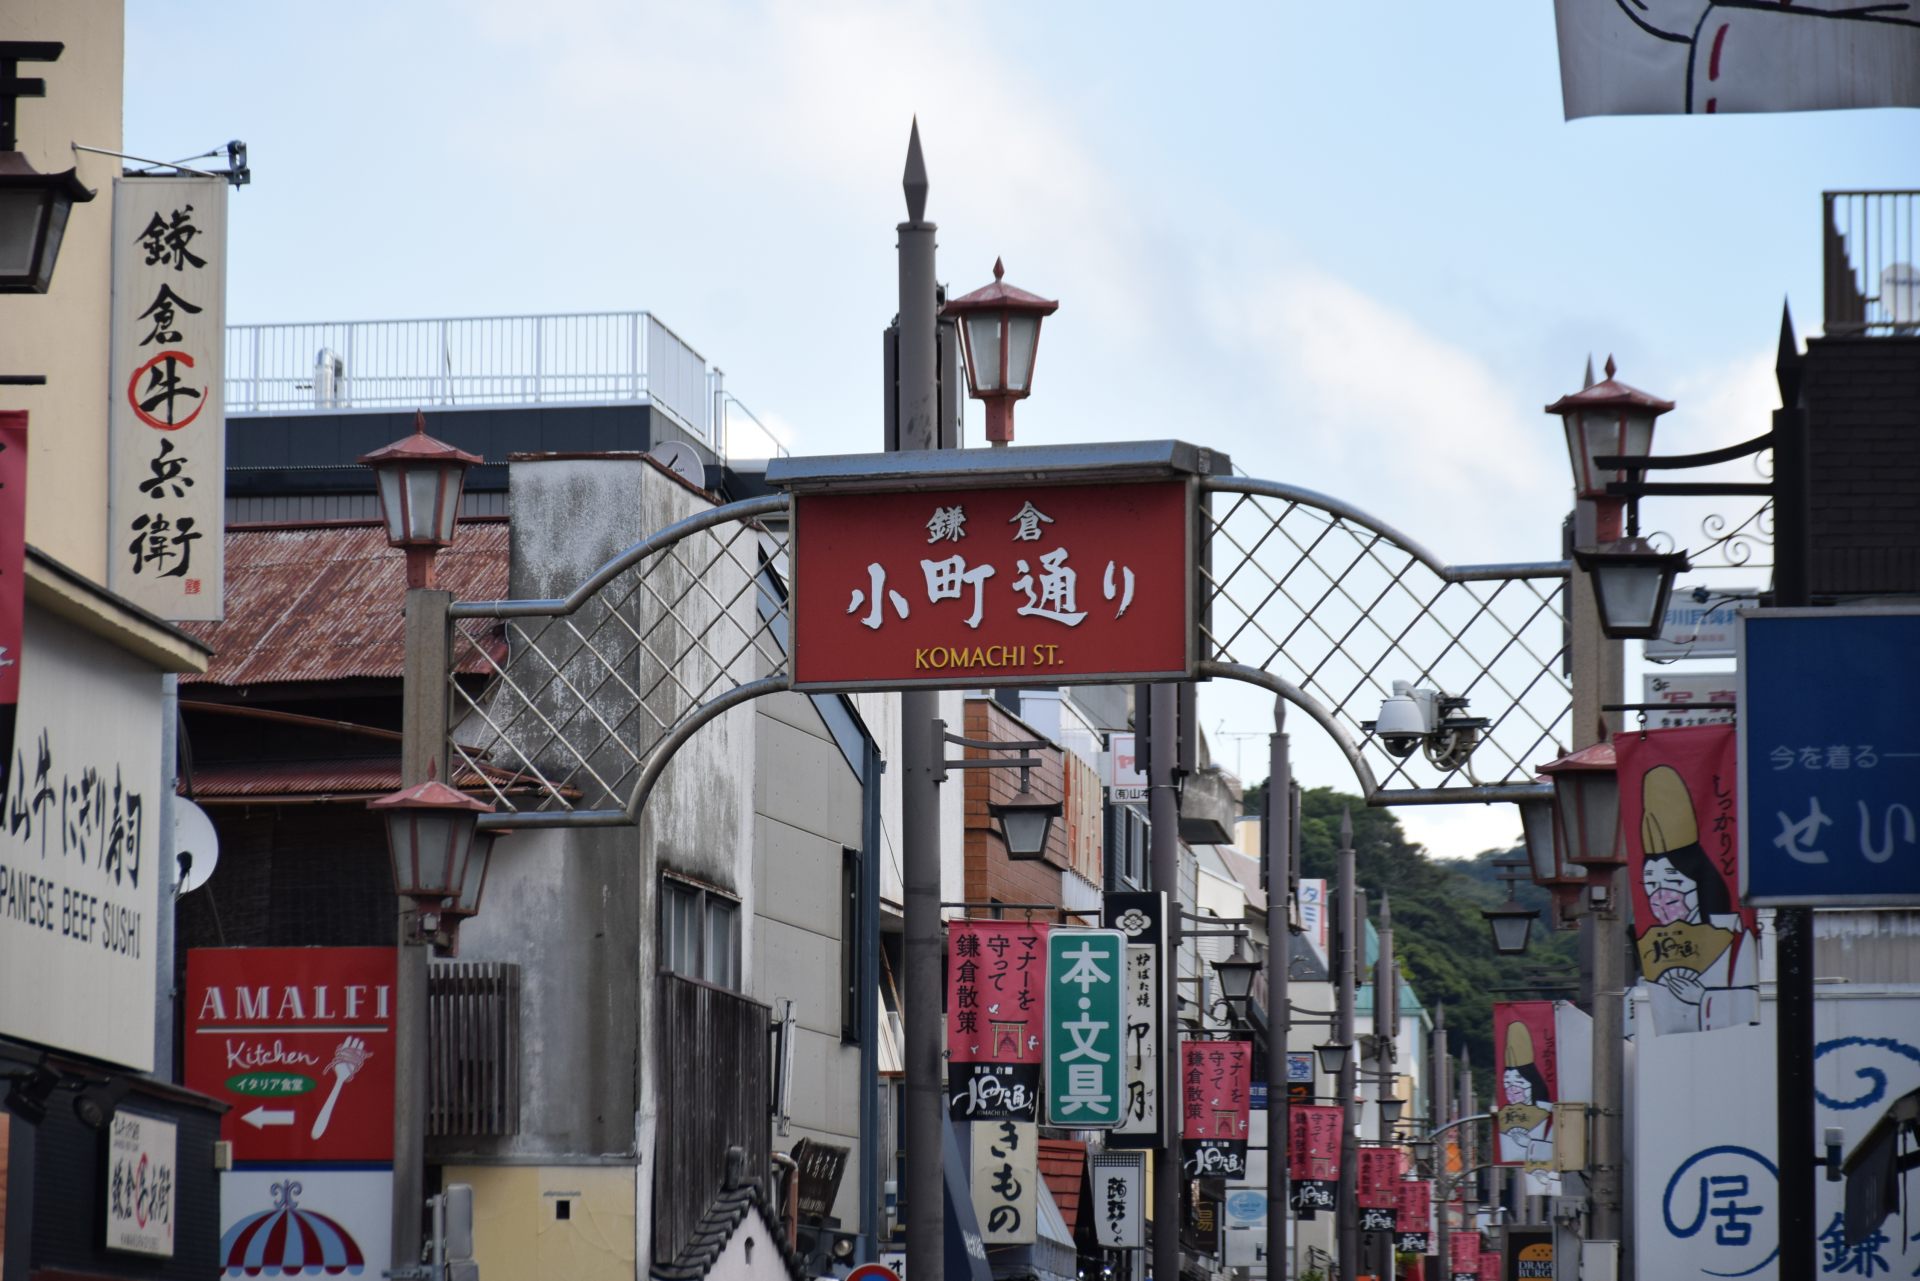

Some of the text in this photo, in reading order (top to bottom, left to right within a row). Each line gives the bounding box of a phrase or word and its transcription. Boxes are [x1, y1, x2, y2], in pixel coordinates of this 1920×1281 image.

[129, 204, 208, 578] 鎌倉牛兵衛
[925, 501, 1055, 544] 鎌倉
[847, 547, 1135, 629] 小町通り
[915, 644, 1064, 669] KOMACHI ST.
[62, 886, 97, 943] BEEF
[102, 900, 142, 960] SUSHI
[956, 934, 981, 1035] 鎌倉散策
[987, 934, 1011, 992] 守って
[1016, 936, 1038, 1011] マナーを
[1136, 953, 1151, 1008] 炉ばた焼
[198, 985, 390, 1020] AMALFI
[226, 1039, 320, 1069] Kitchen
[1230, 1051, 1244, 1103] マナーを
[236, 1078, 304, 1092] イタリア食堂
[988, 1120, 1022, 1233] きもの
